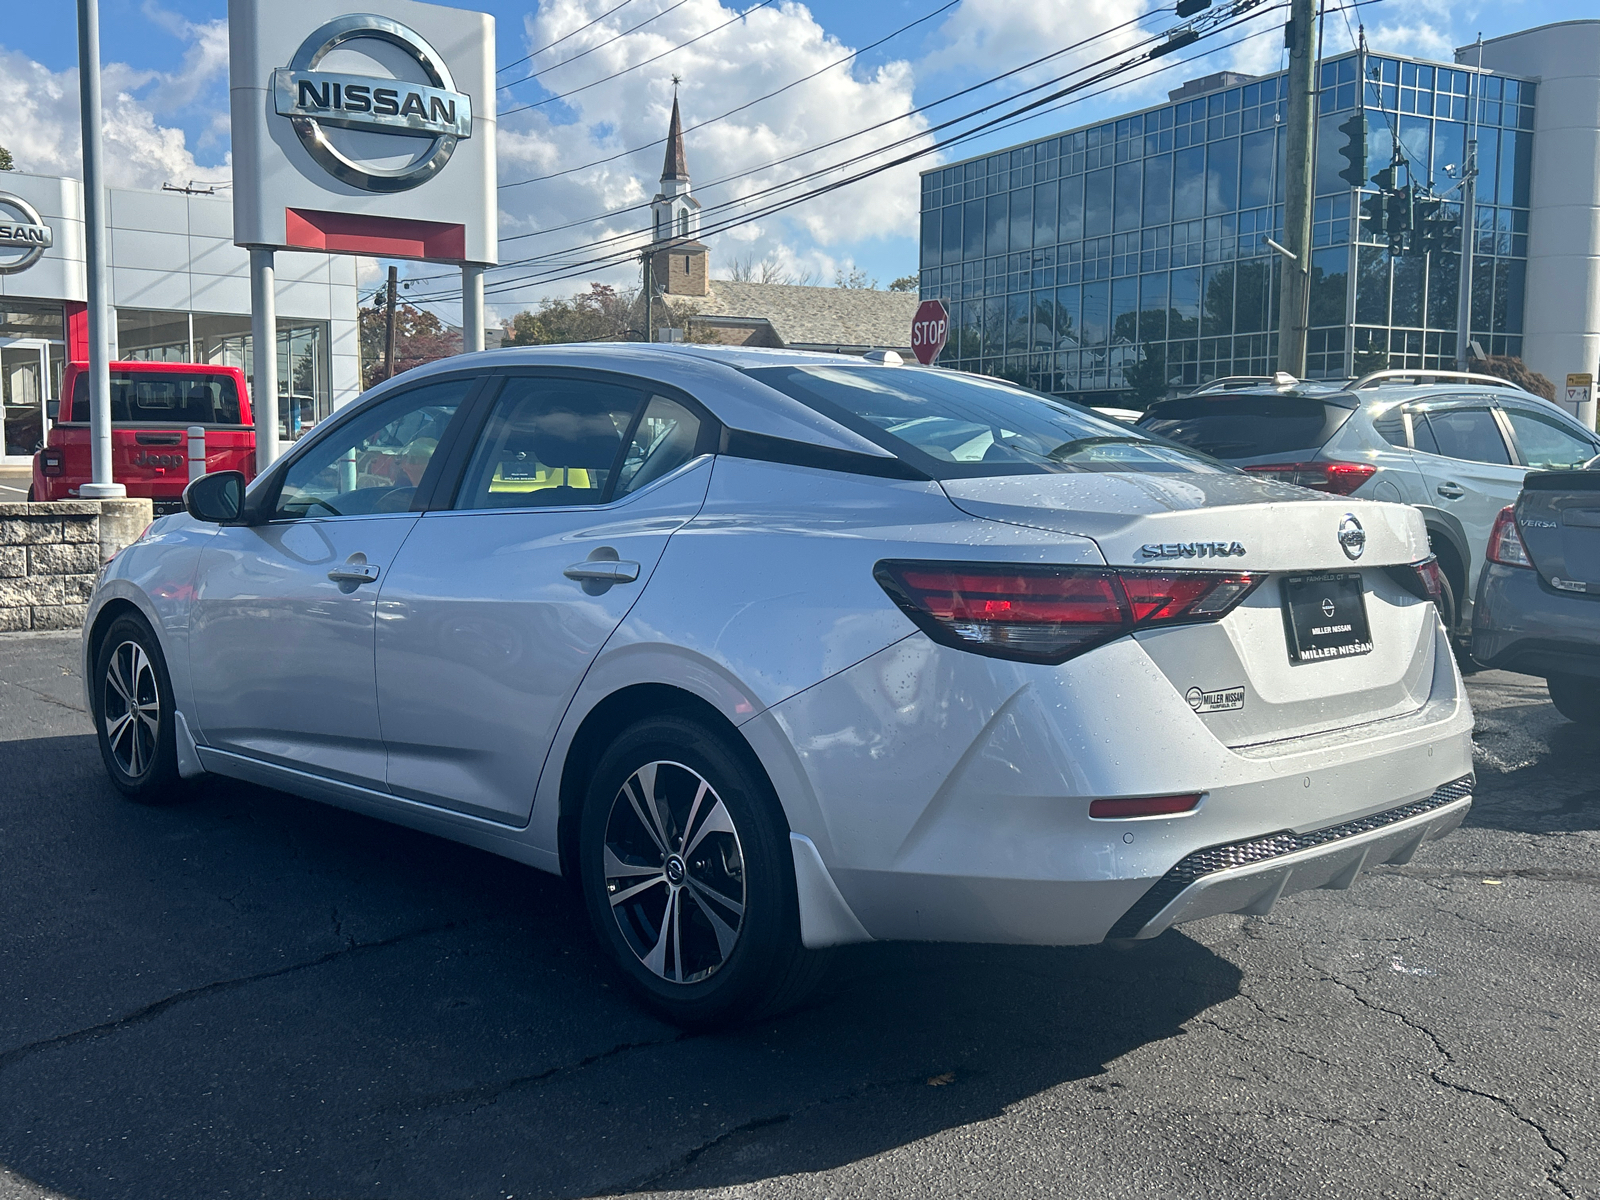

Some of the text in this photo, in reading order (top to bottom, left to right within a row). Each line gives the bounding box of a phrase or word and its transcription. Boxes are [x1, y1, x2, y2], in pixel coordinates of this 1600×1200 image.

[298, 79, 456, 124] NISSAN
[913, 320, 946, 346] STOP
[134, 450, 184, 470] Jeep
[1520, 519, 1557, 529] VERSA
[1141, 541, 1247, 559] SENTRA
[1312, 625, 1352, 635] MILLER NISSAN
[1301, 643, 1373, 660] MILLER NISSAN
[1203, 692, 1244, 705] MILLER NISSAN
